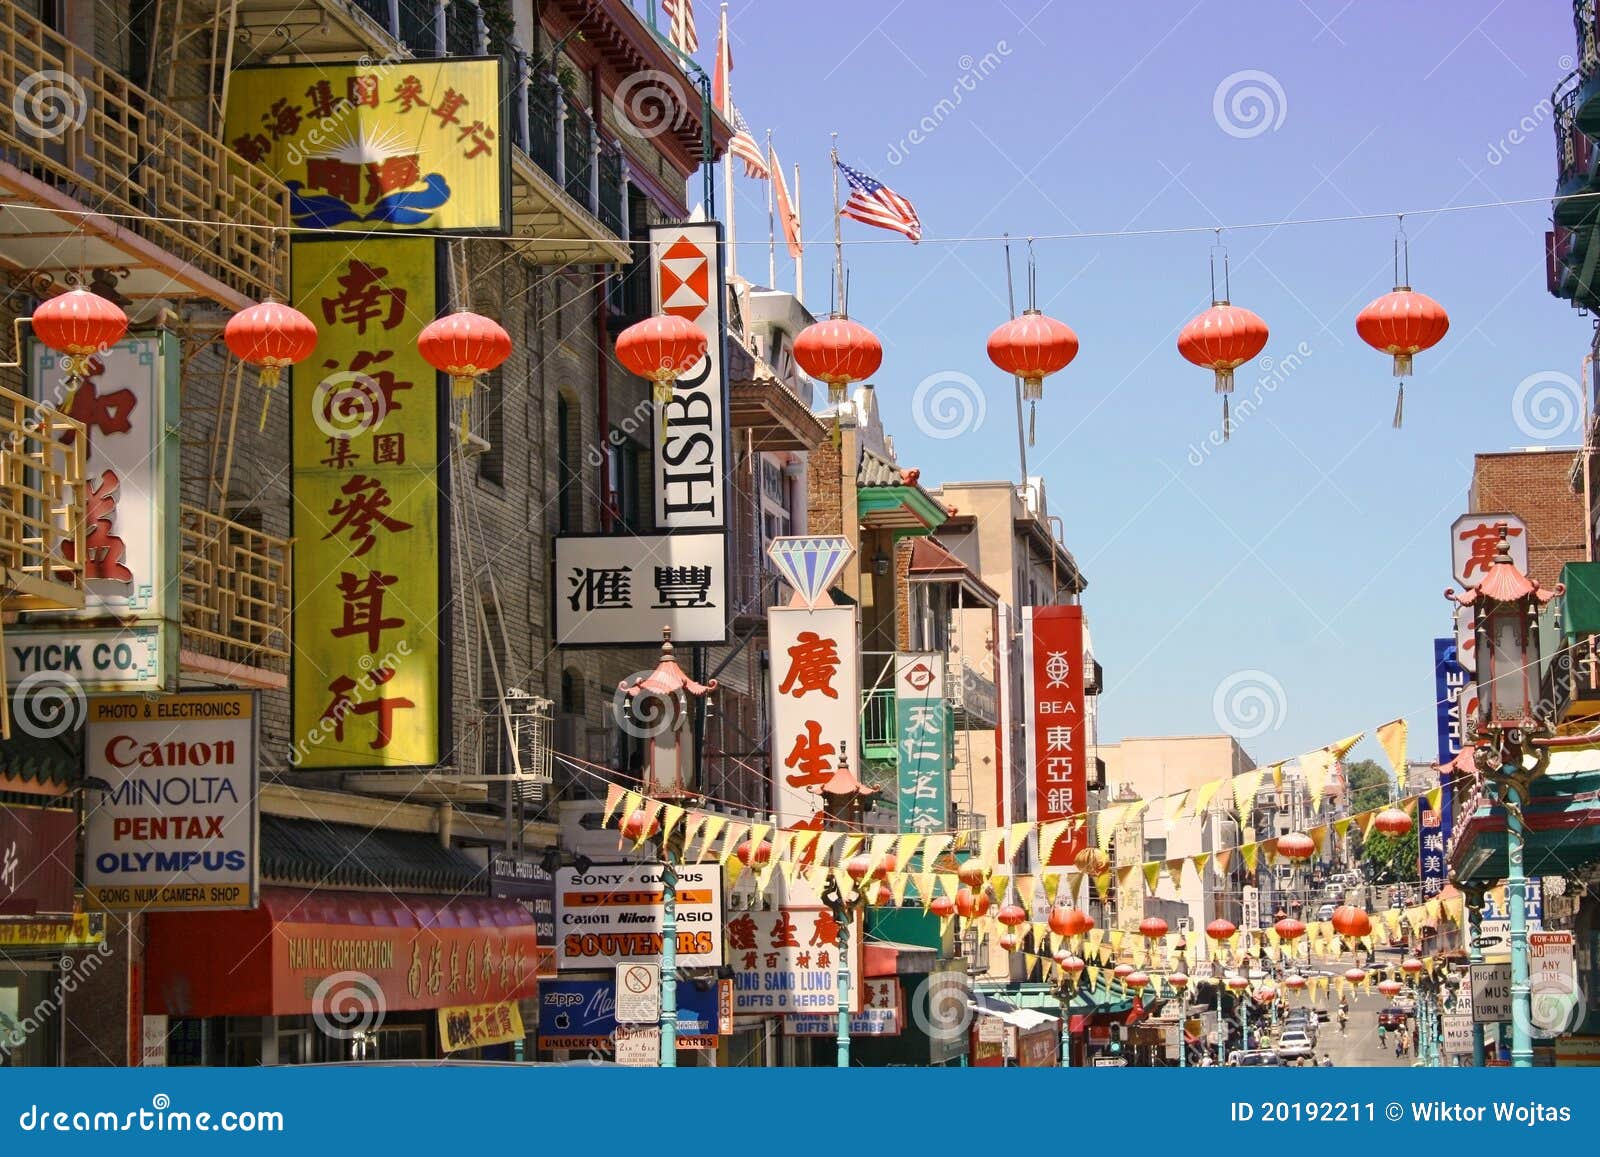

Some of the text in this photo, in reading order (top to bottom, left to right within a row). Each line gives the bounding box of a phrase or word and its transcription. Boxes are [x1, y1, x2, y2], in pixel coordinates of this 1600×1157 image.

[13, 643, 137, 673] YICK CO.
[99, 702, 240, 718] PHOTO & ELECTRONICS
[1040, 701, 1076, 714] BEA
[1447, 671, 1464, 755] CHASE
[105, 735, 234, 768] Canon
[102, 777, 238, 806] MINOLTA
[114, 816, 224, 841] PENTAX
[96, 850, 245, 873] OLYMPUS
[571, 874, 703, 885] SONY OLYPUS
[100, 887, 239, 903] GONG NUM CAMERA SHOP
[562, 912, 713, 925] Canon Nikon ASIO
[564, 930, 714, 957] SOUVENRS
[1533, 935, 1570, 944] TOW-AWAY
[289, 938, 310, 969] NAM
[331, 938, 393, 969] CORPORATION
[1532, 945, 1544, 957] NO
[1542, 961, 1560, 970] ANY
[765, 971, 796, 991] SANG
[801, 971, 831, 991] LUNG
[1474, 971, 1498, 981] RIGHT
[1485, 986, 1509, 998] MUS
[545, 992, 584, 1007] zippo
[737, 995, 774, 1007] GIFTS
[793, 994, 835, 1007] HERBS
[1476, 1005, 1498, 1015] TURN
[631, 1029, 657, 1040] PARKING
[679, 1037, 713, 1047] CARDS
